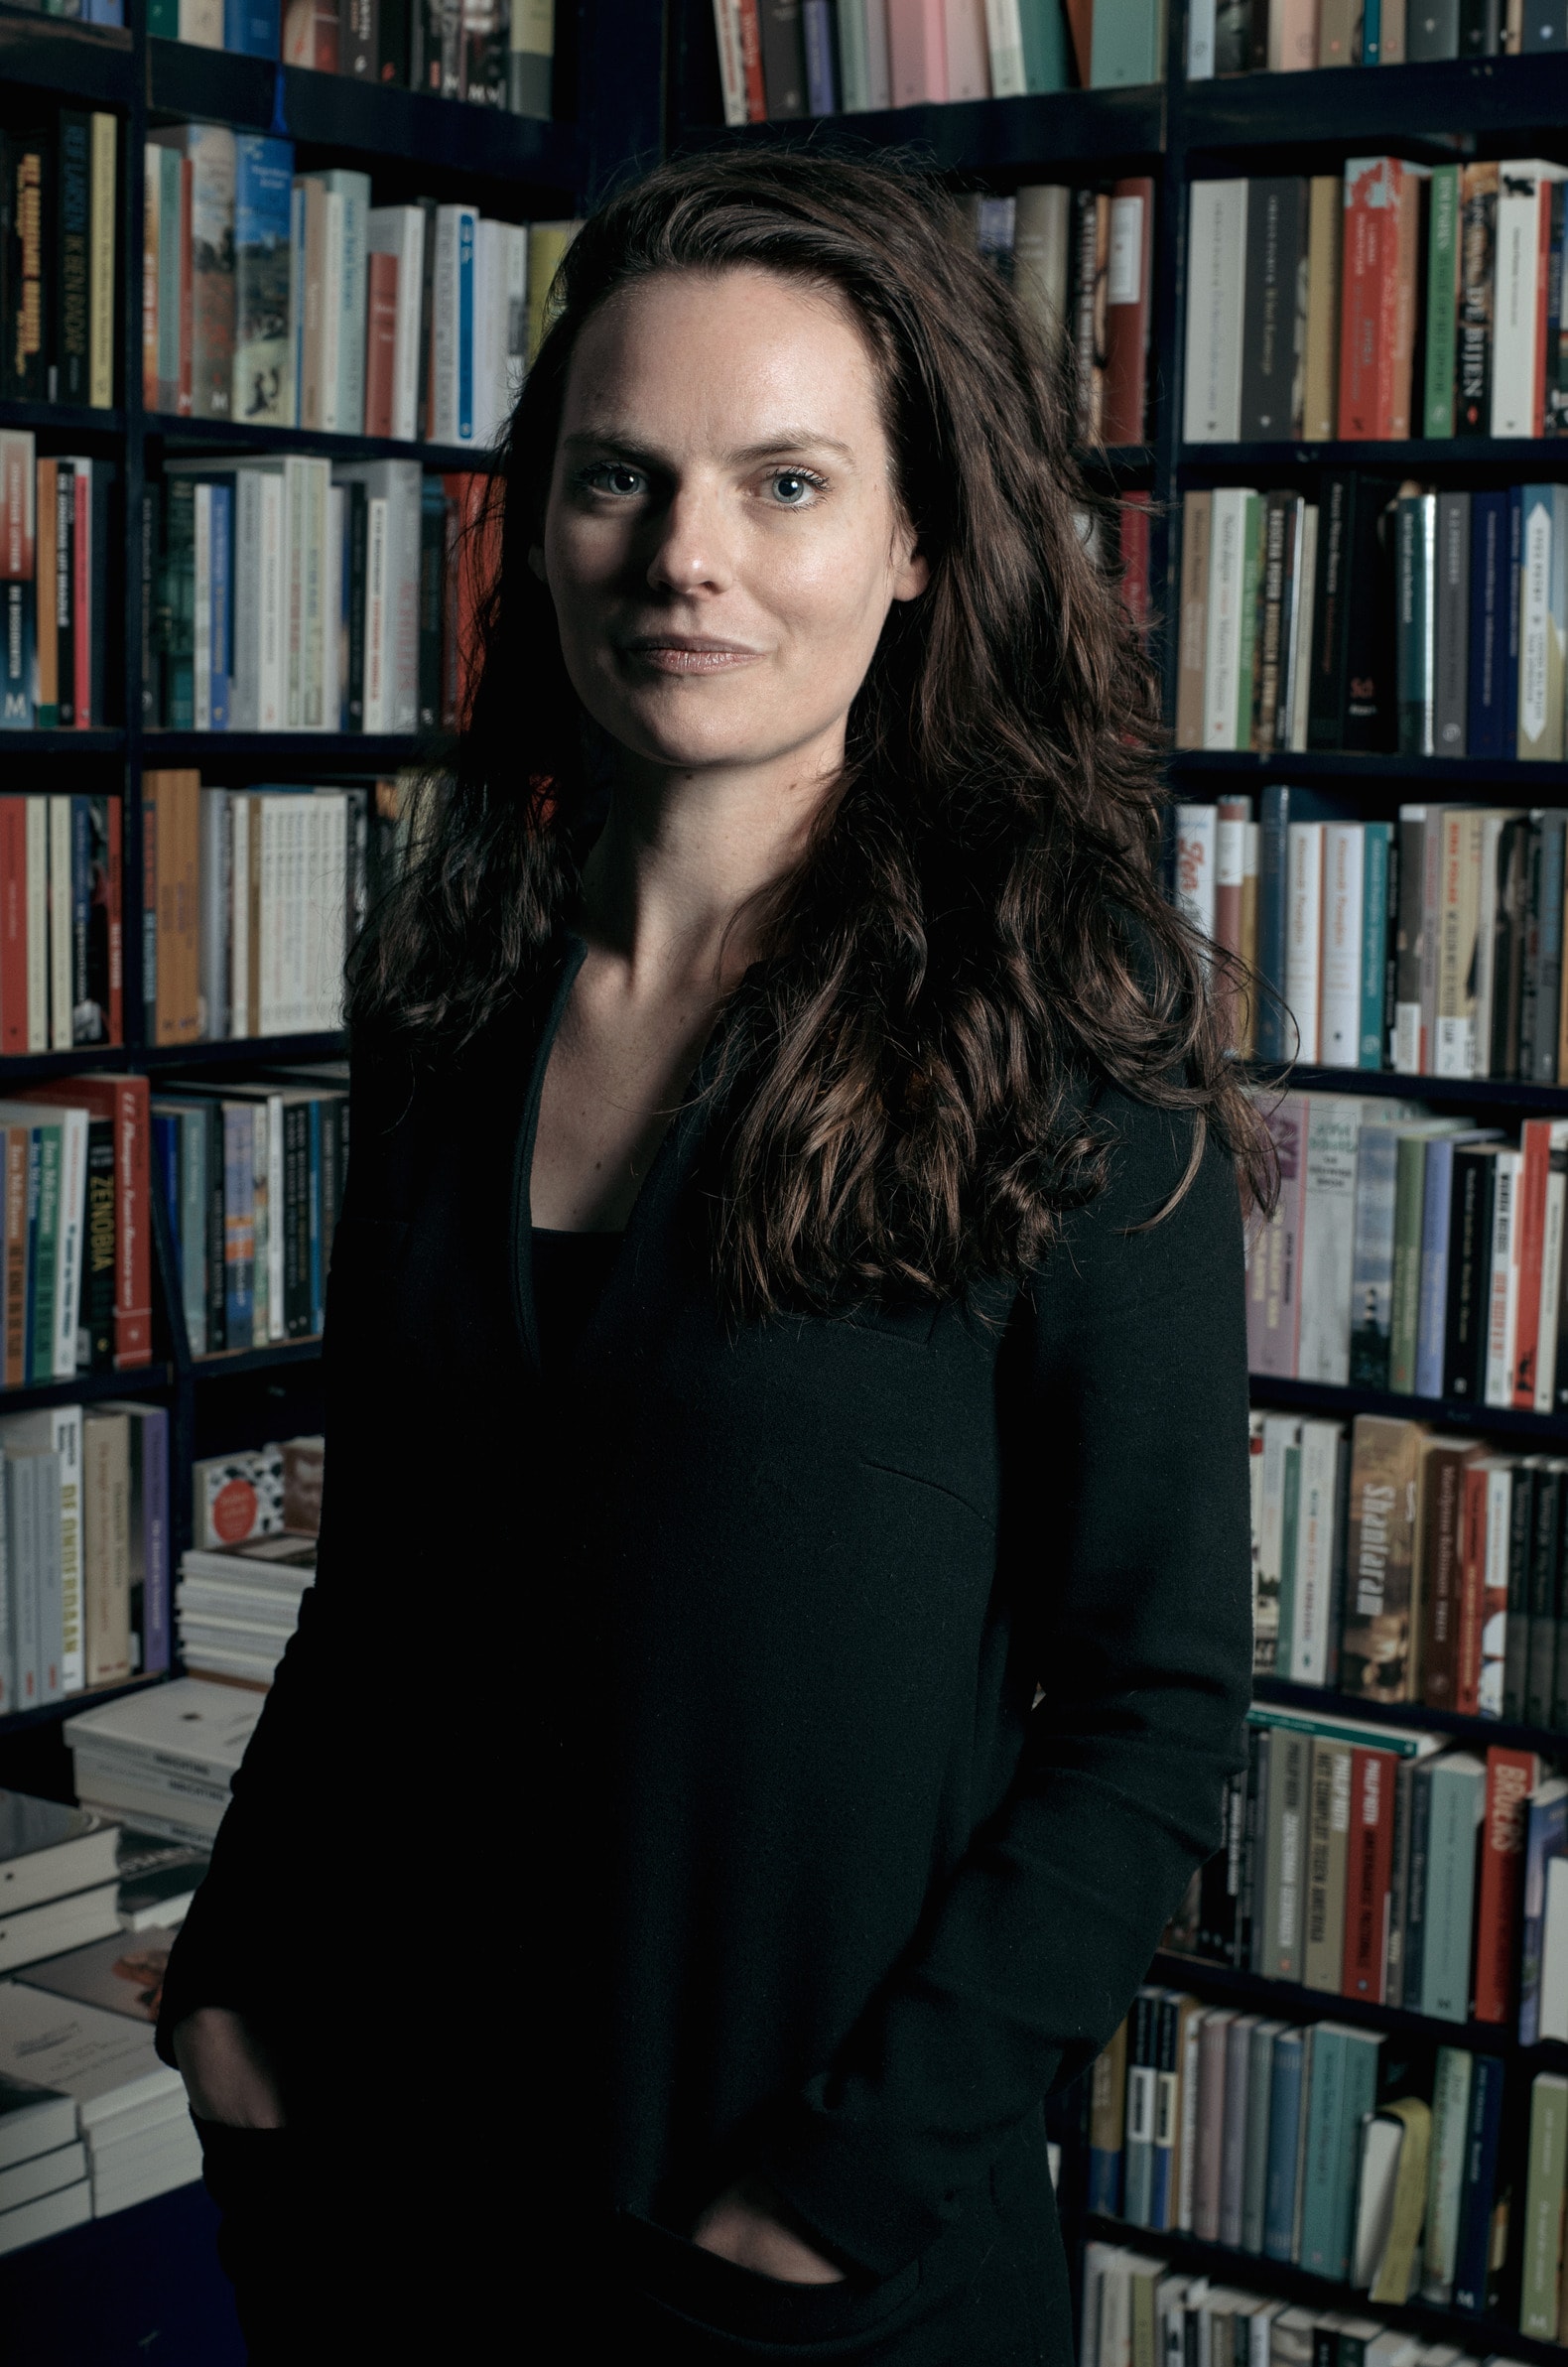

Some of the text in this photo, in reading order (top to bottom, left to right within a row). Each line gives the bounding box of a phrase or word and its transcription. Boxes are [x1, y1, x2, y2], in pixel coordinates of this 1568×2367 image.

[63, 163, 87, 233] LARSEN
[63, 254, 86, 291] BEN
[63, 295, 86, 355] RADAR
[1462, 286, 1486, 398] DE BIJEN
[5, 693, 27, 719] M
[90, 1174, 114, 1272] ZENOBIA
[1355, 1483, 1397, 1616] Shantaram
[1331, 1754, 1352, 1833] PHILIP ROTH
[1363, 1759, 1381, 1793] PHILIP
[1362, 1794, 1379, 1826] ROTH
